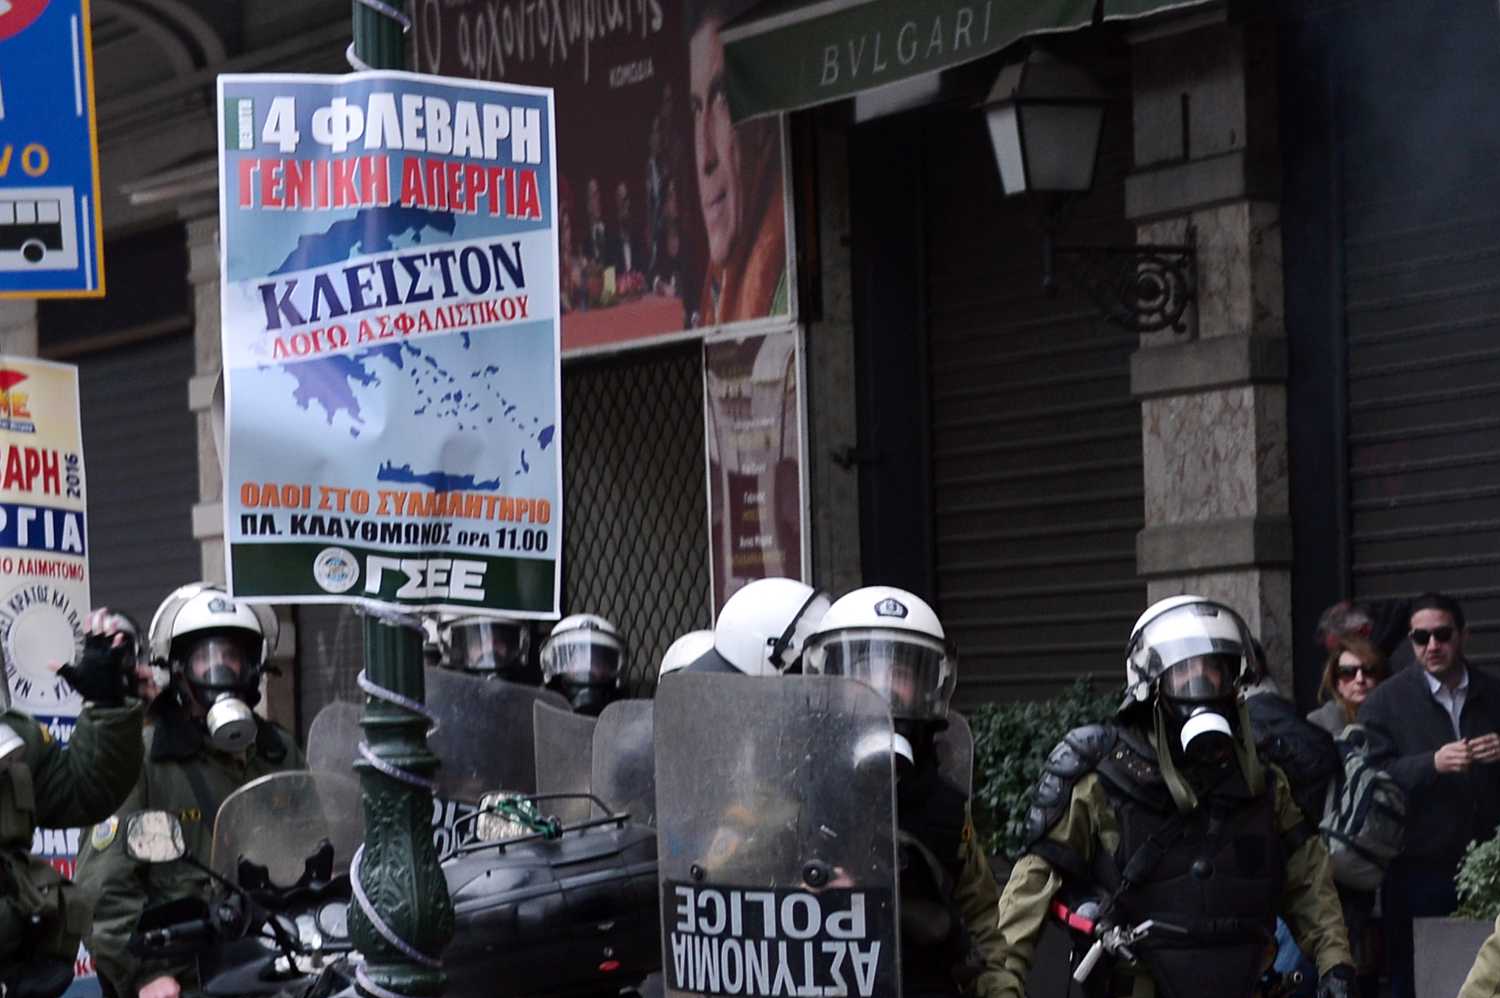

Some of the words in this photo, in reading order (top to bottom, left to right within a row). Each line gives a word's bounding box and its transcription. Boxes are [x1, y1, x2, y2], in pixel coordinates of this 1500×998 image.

[818, 1, 992, 86] BVLGARI
[261, 96, 300, 152] 4
[311, 92, 542, 164] ΦΛΕΒΑΡΗ
[238, 156, 391, 212] ΓΕΝΙΚΗ
[400, 157, 543, 221] ΑΠΕΡΓΙΑ
[258, 240, 526, 331] ΚΛΕΙΣΤΟΝ
[272, 326, 349, 359] ΛΟΓΩ
[357, 295, 529, 343] ΑΣΦΑΛΙΣΤΙΚΟΥ
[0, 443, 61, 496] ΑΡΗ
[65, 453, 81, 499] 2016
[240, 482, 312, 510] ΟΛΟΙ
[318, 485, 370, 513] ΣΤΟ
[376, 489, 551, 525] ΣΥΛΛΑΛΗΤΗΡΙΟ
[240, 513, 283, 536] ΠΛ.
[290, 514, 453, 545] ΚΛΑΥΘΜΩΝΟΣ
[457, 530, 491, 548] ΩΡΑ
[496, 528, 549, 552] 11.00
[365, 555, 488, 601] ΓΣΕΕ
[675, 885, 867, 940] POLICE
[670, 931, 881, 998] ΑΣΤΥΝΟΜΙΑ
